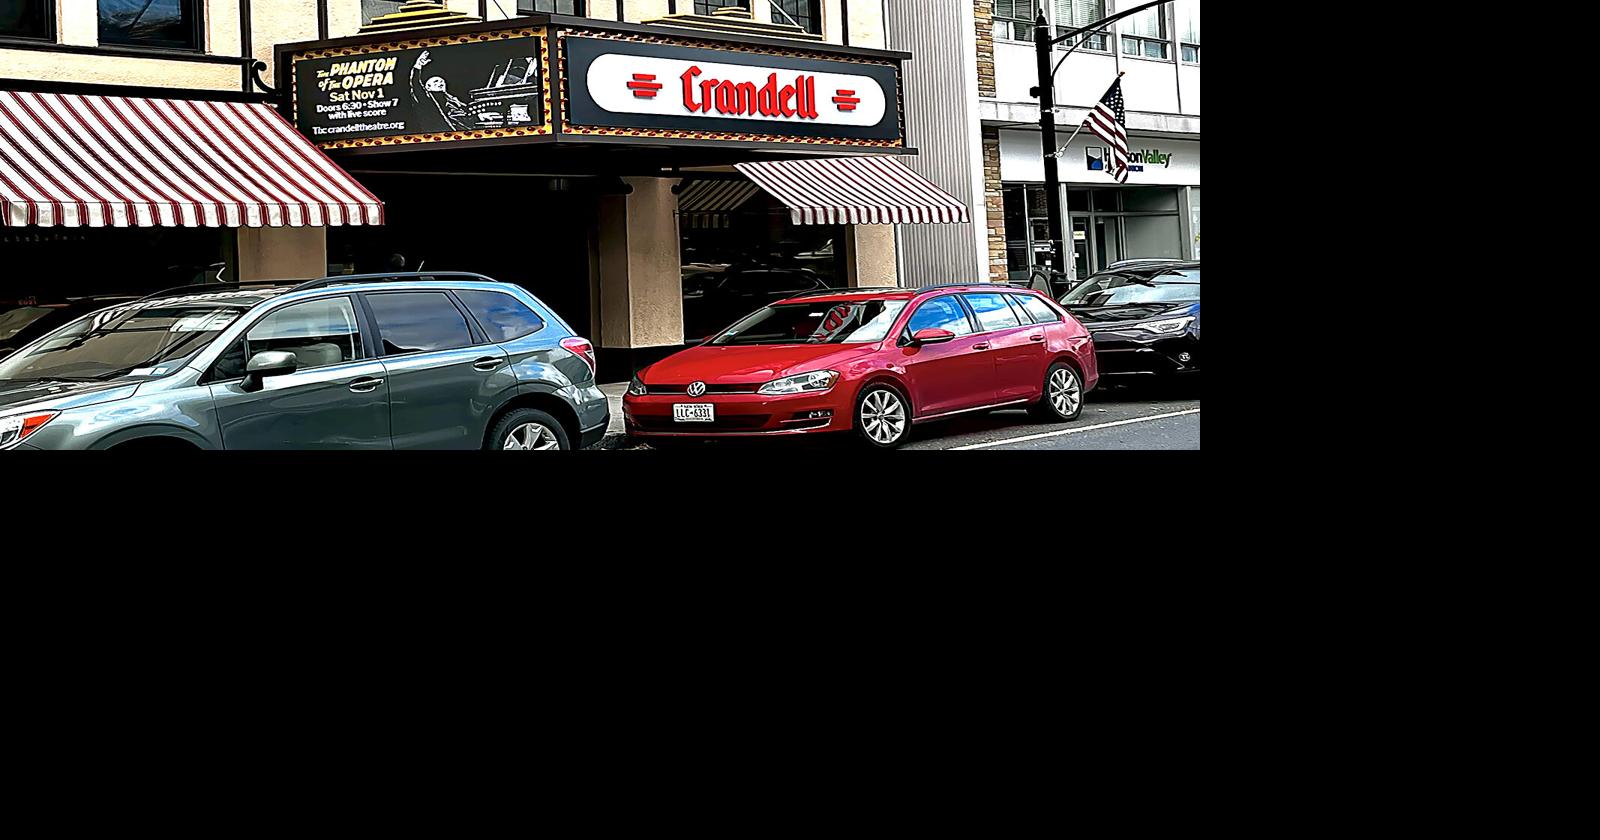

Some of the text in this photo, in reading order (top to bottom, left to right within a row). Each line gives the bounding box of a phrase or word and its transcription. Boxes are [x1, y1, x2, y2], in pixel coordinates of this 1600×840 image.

[329, 57, 397, 76] PHANTOM
[318, 78, 330, 91] of
[341, 72, 393, 89] OPERA
[329, 88, 384, 102] Sat Nov 1
[680, 65, 819, 120] Crandell
[316, 98, 399, 113] Doors 6:30 Show 7
[328, 108, 387, 120] with live score
[327, 122, 405, 133] crandelltheatre.org
[676, 408, 711, 418] LLC-6331
